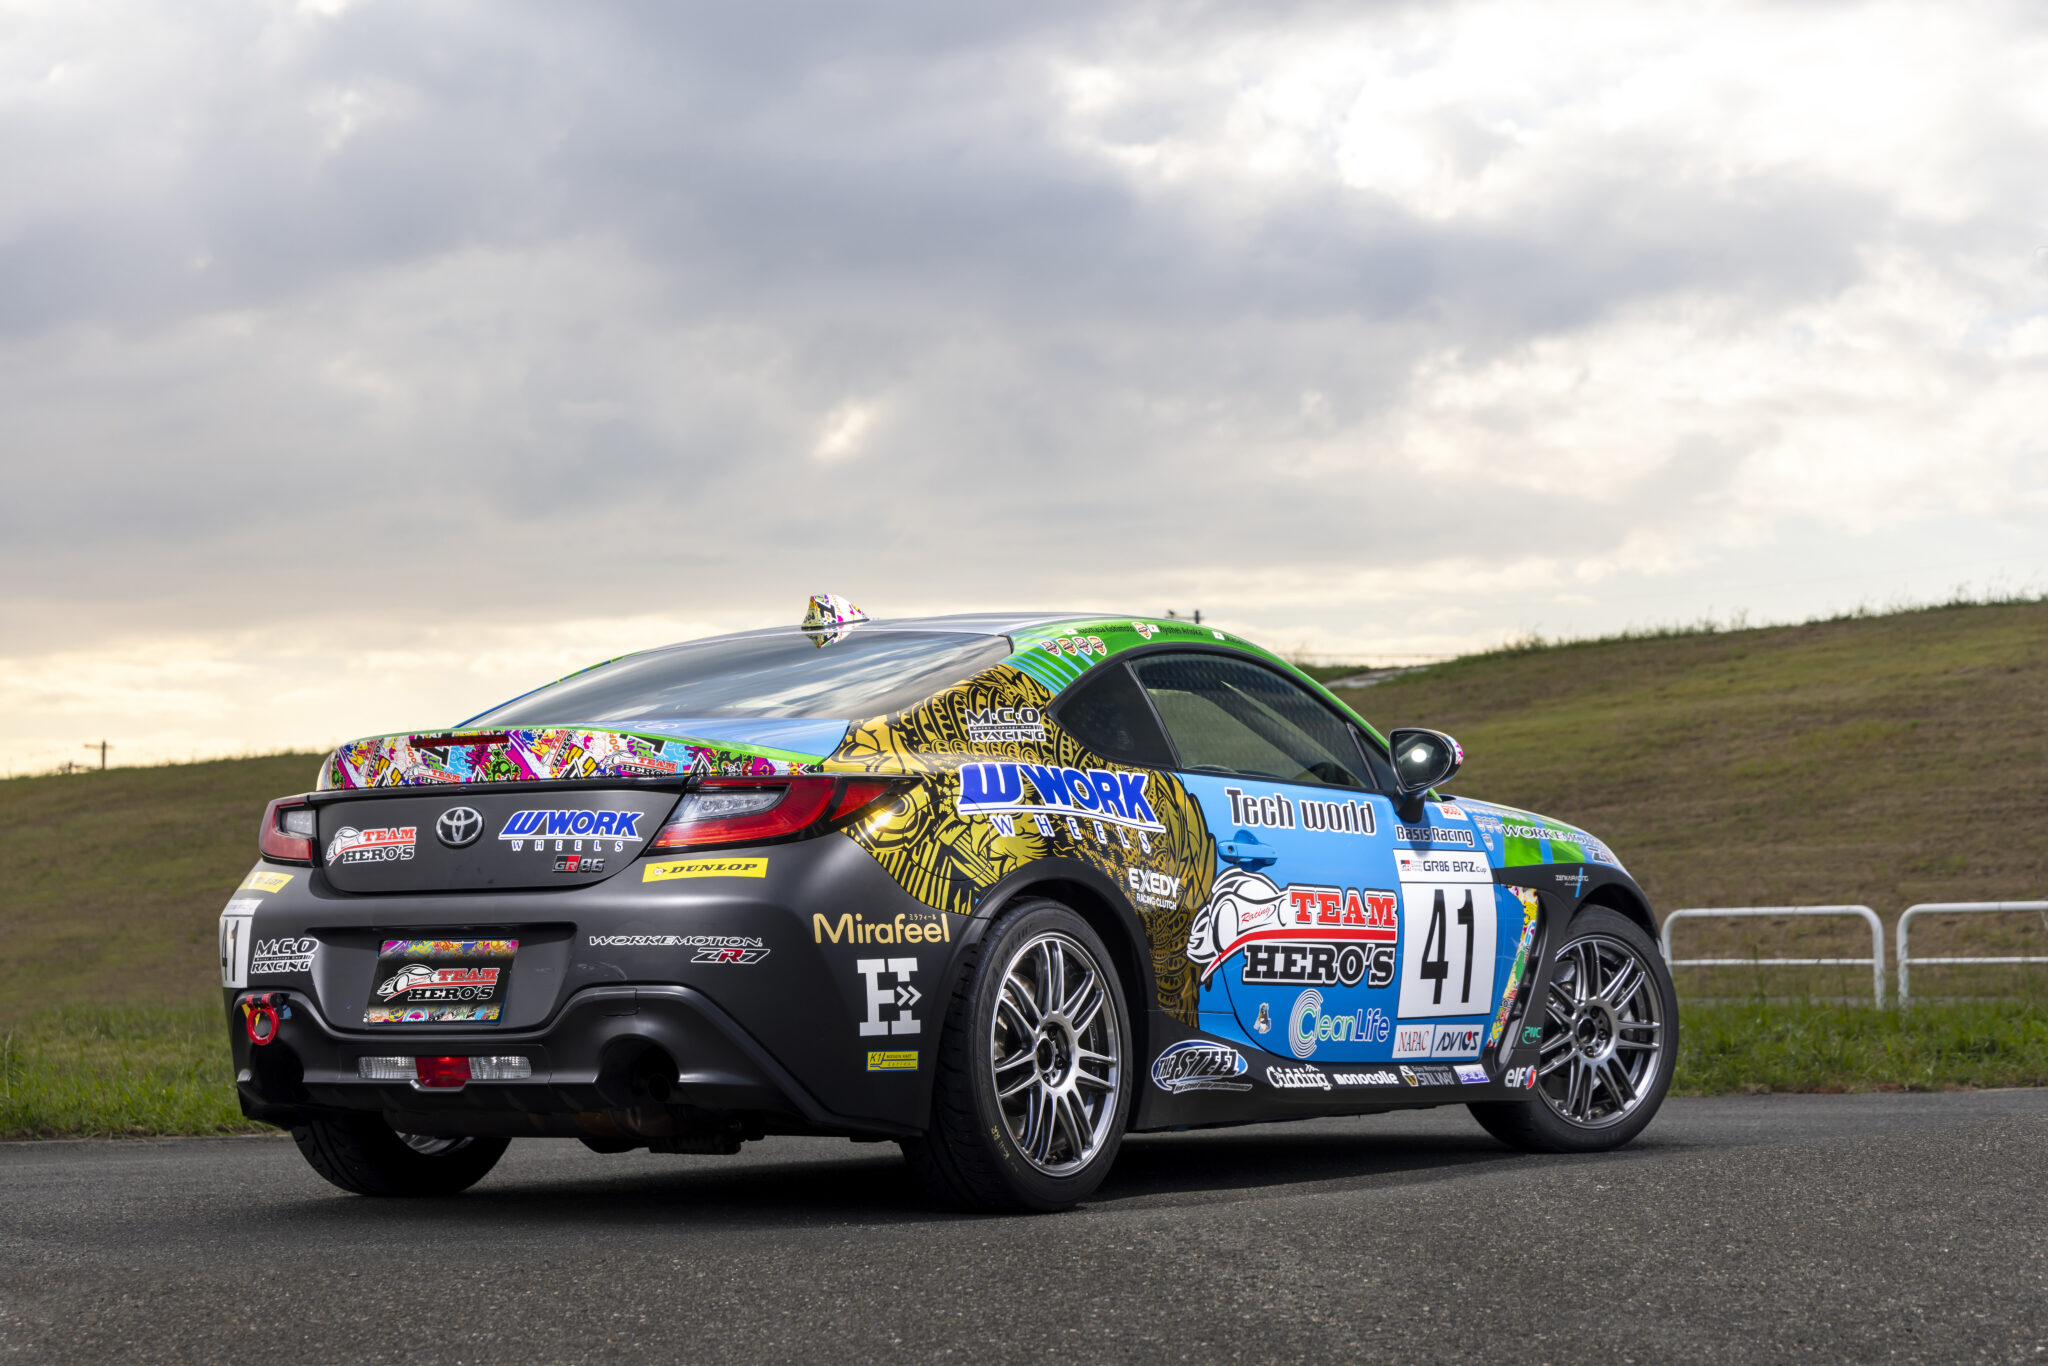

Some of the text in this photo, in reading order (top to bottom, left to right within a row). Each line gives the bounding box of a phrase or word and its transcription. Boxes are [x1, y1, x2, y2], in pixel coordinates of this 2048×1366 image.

[970, 730, 1047, 742] RACING
[637, 755, 677, 769] TEAM
[431, 769, 461, 782] TEAM
[1224, 787, 1377, 836] Tech world
[363, 827, 417, 842] TEAM
[990, 815, 1151, 854] WHEELS
[1394, 824, 1475, 848] Basis Racing
[343, 845, 415, 864] HERO'S
[511, 840, 624, 852] WHEELS
[669, 863, 758, 874] DUNLOP
[1423, 860, 1450, 872] GR86
[1453, 861, 1476, 873] BRZ
[1128, 867, 1181, 898] EXEDY
[1241, 905, 1271, 924] Racing
[1290, 891, 1397, 927] TEAM
[813, 913, 950, 944] Mirafeel
[691, 947, 771, 964] ZR7
[1420, 889, 1475, 1004] 41
[251, 960, 311, 975] RACING
[1243, 943, 1396, 985] HERO'S
[436, 968, 500, 982] TEAM
[408, 985, 495, 1002] HERO'S
[1299, 1007, 1390, 1043] CleanLife
[1399, 1030, 1430, 1052] NAPAC
[1436, 1030, 1480, 1051] ADVICS
[1154, 1049, 1240, 1080] THE STEEL
[1333, 1070, 1400, 1085] monocolle
[1504, 1067, 1527, 1088] elf
